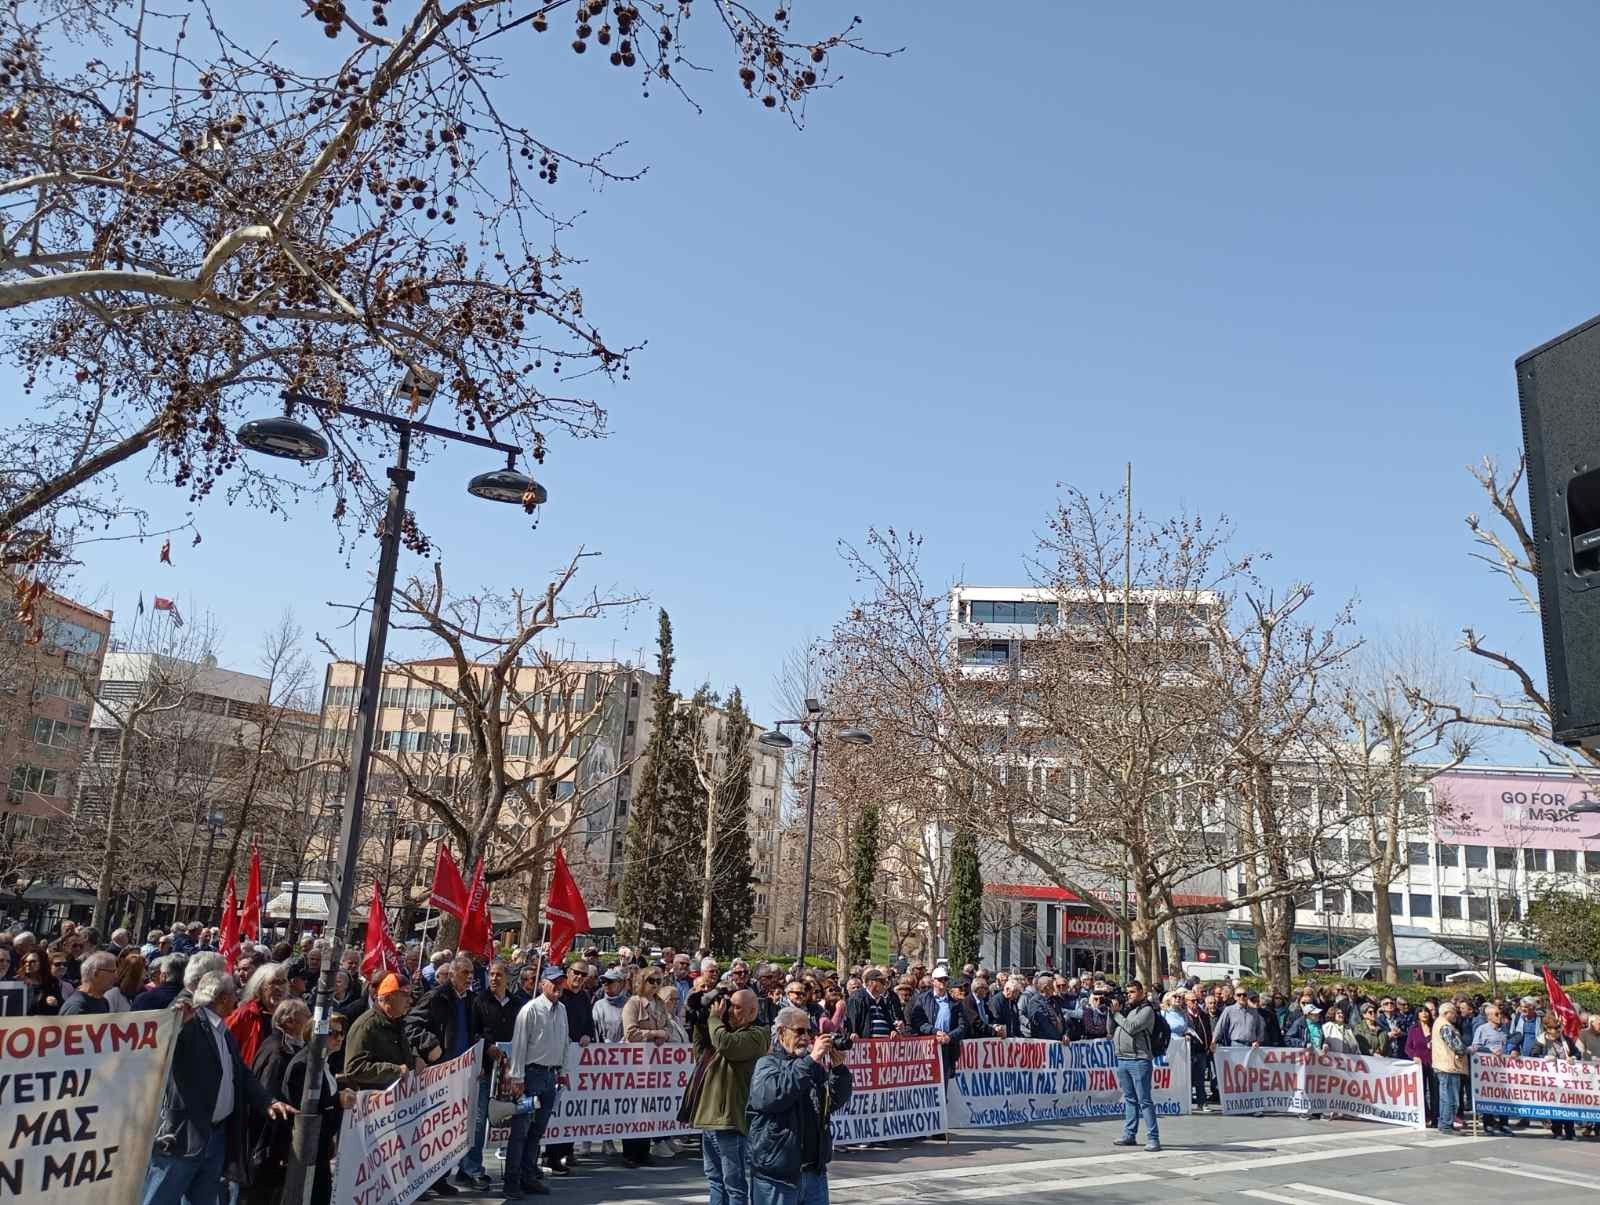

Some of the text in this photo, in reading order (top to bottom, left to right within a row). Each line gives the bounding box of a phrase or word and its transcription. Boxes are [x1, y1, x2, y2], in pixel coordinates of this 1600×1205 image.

[1501, 792, 1566, 806] GO FOR
[578, 1047, 695, 1066] ΔΩΣΤΕ ΛΕΦΤ
[955, 1040, 979, 1070] ΛΟΙ
[983, 1041, 1005, 1069] ΣΤΟ
[1049, 1043, 1064, 1069] ΝΑ
[1068, 1040, 1119, 1069] ΥΠΕΡΑΣΠ
[1264, 1050, 1370, 1073] ΔΗΜΟΣΙΑ
[1480, 1055, 1549, 1073] ΕΠΑΝΑΦΟΡΑ
[1582, 1063, 1590, 1073] &
[577, 1070, 672, 1091] ΣΥΝΤΑΞΕΙΣ
[677, 1070, 688, 1088] &
[878, 1063, 934, 1086] ΚΑΡΔΙΤΣΑΣ
[956, 1068, 1171, 1097] ΤΑ ΔΙΚΑΙΩΜΑΤΑ ΜΑΣ ΣΤΗΝ ΥΓΕΙΑ ΩΗ
[1223, 1059, 1418, 1107] ΔΩΡΕΑΝ ΠΕΡΙΘΑΛΨΗ
[1480, 1070, 1558, 1088] ΑΥΞΗΣΕΙΣ
[1563, 1079, 1594, 1091] ΣΤΙΣ
[871, 1092, 878, 1114] &
[880, 1086, 940, 1113] ΔΙΕΚΔΙΚΟΥΜΕ
[1225, 1096, 1265, 1111] ΣΥΛΛΟΓΟΣ
[1267, 1096, 1328, 1111] ΣΥΝΤΑΞΙΟΥΧΩΝ
[1329, 1099, 1377, 1115] ΔΗΜΟΣΙΟΥ
[1480, 1086, 1556, 1103] ΑΠΟΚΛΕΙΣΤΙΚΑ
[566, 1099, 589, 1118] ΟΧΙ
[591, 1098, 610, 1116] ΓΙΑ
[614, 1097, 637, 1115] ΤΟΥ
[641, 1096, 672, 1114] ΝΑΤΟ
[675, 1095, 683, 1111] Τ
[8, 1105, 99, 1149] ΜΑΣ
[563, 1120, 655, 1138] ΣΥΝΤΑΞΙΟΥΧΩΝ
[658, 1120, 676, 1131] ΙΚΑ
[854, 1118, 880, 1139] ΜΑΣ
[883, 1111, 941, 1136] ΑΝΗΚΟΥΝ
[355, 1134, 407, 1187] ΔΜΟΣΙΑ
[411, 1095, 470, 1145] ΔΩΡΕΑΝ
[390, 1154, 415, 1185] ΓΙΑ
[419, 1117, 469, 1163] ΟΛΟΥΣ
[41, 1145, 120, 1192] ΜΑΣ
